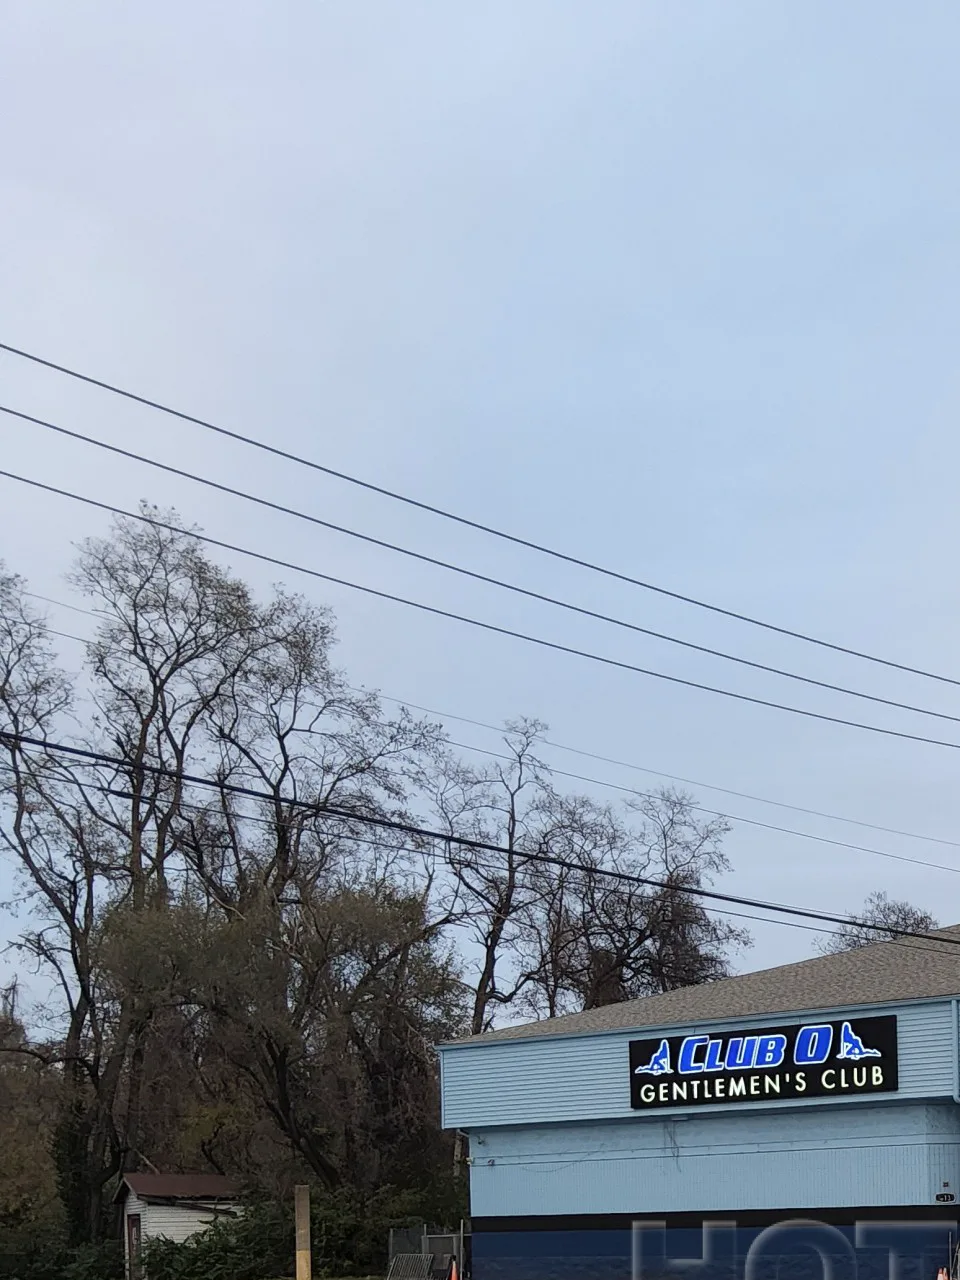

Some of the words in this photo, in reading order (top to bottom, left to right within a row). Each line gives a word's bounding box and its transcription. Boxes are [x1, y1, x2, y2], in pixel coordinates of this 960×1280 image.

[678, 1034, 787, 1075] CLUB
[794, 1024, 833, 1065] O
[640, 1072, 807, 1103] GENTLEMEN'S
[821, 1066, 884, 1090] CLUB
